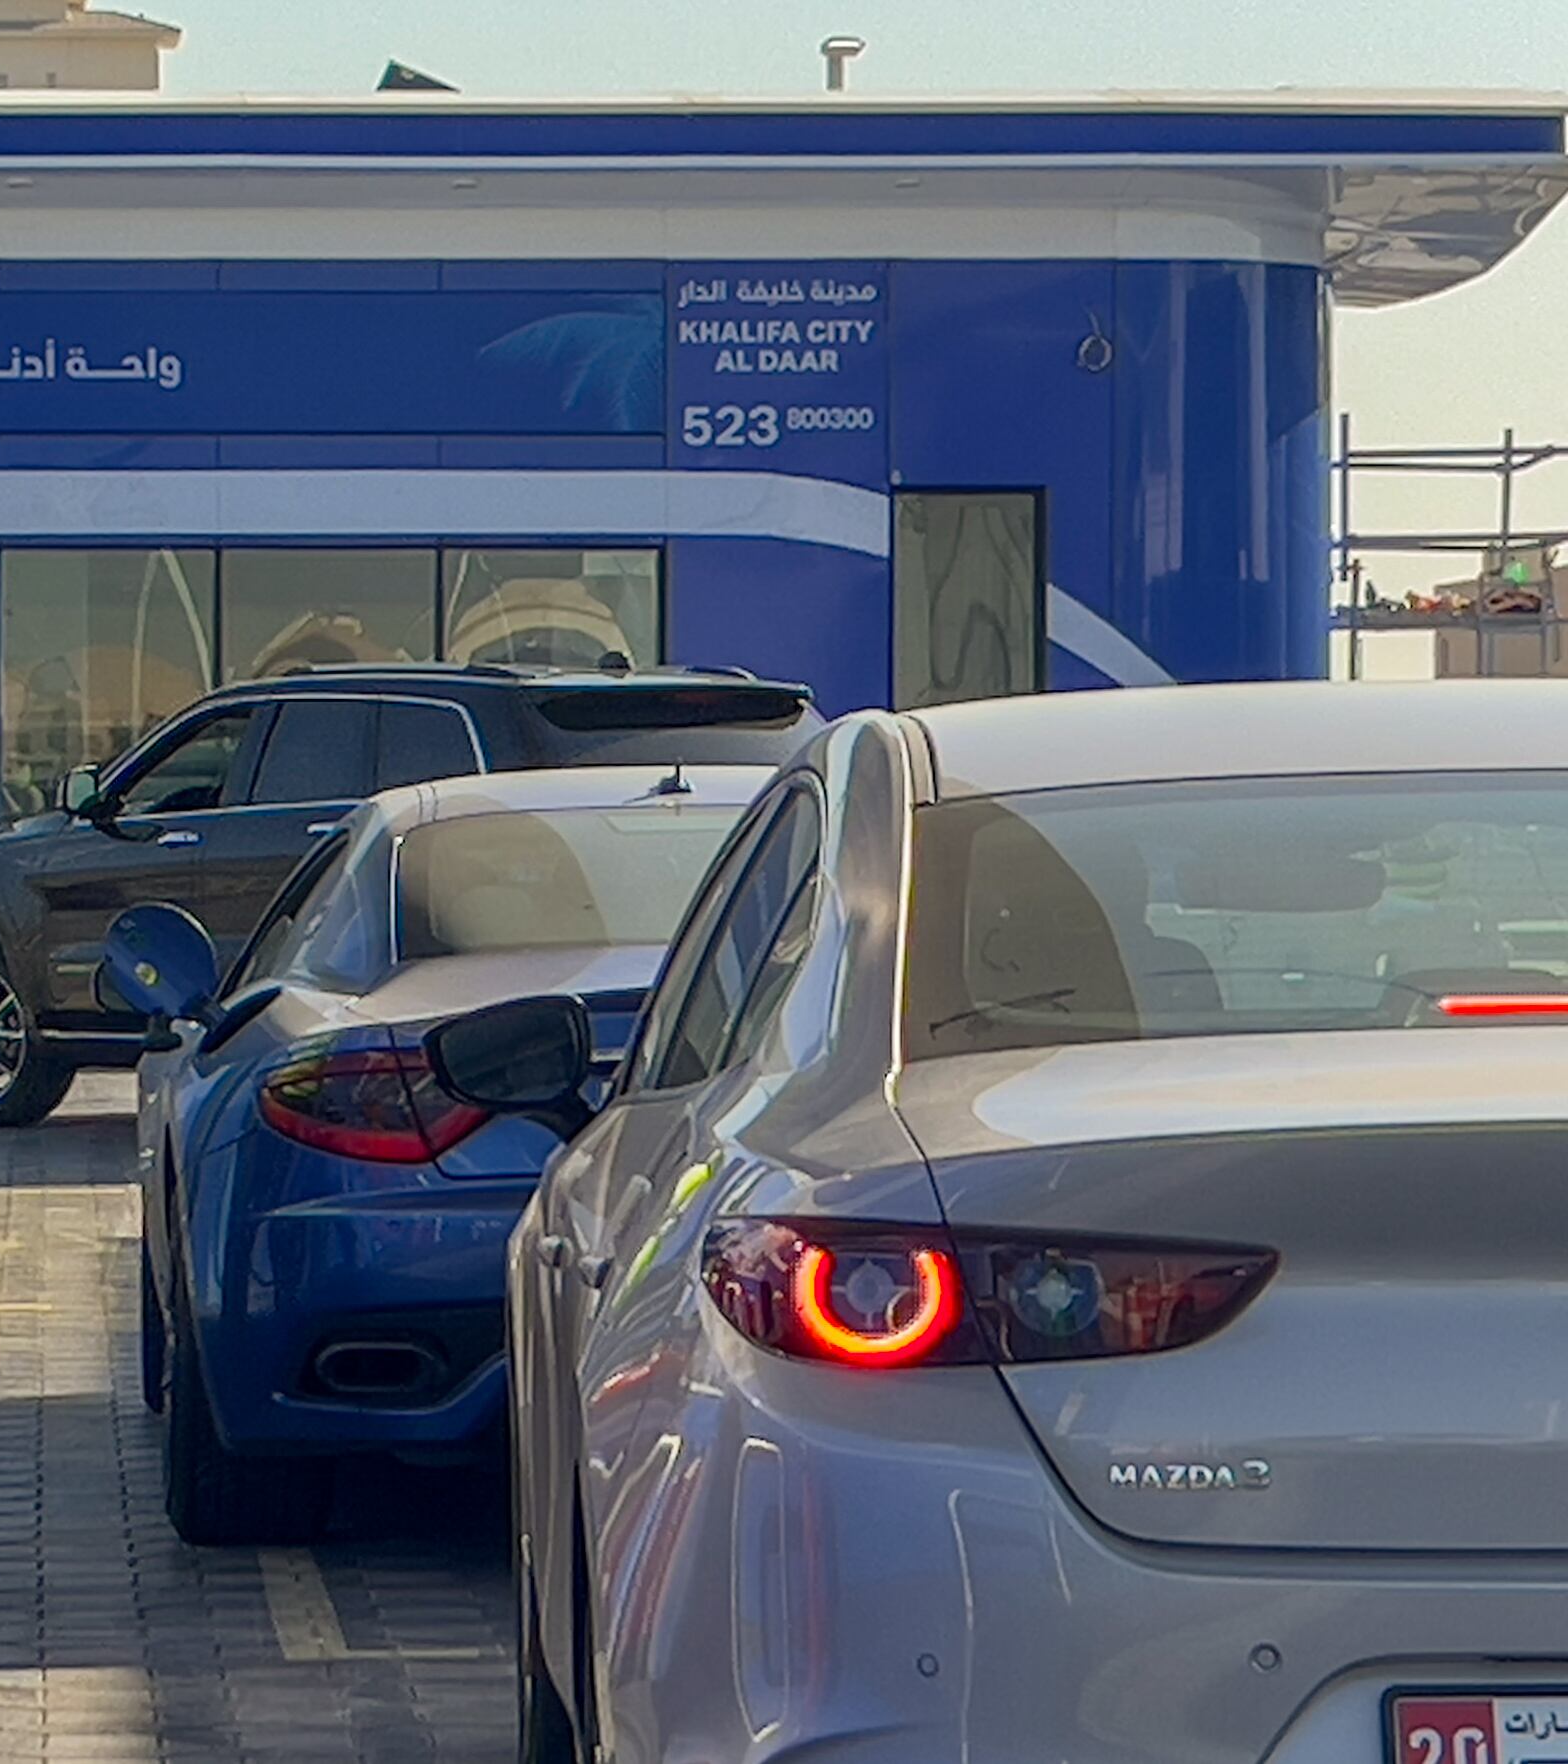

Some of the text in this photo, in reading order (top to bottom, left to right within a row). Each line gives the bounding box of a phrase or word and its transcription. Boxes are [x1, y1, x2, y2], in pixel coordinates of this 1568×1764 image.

[736, 279, 805, 307] خليفة
[678, 319, 874, 344] KHALIFA CITY
[714, 350, 840, 373] AL DAAR
[683, 405, 874, 446] 523 800300
